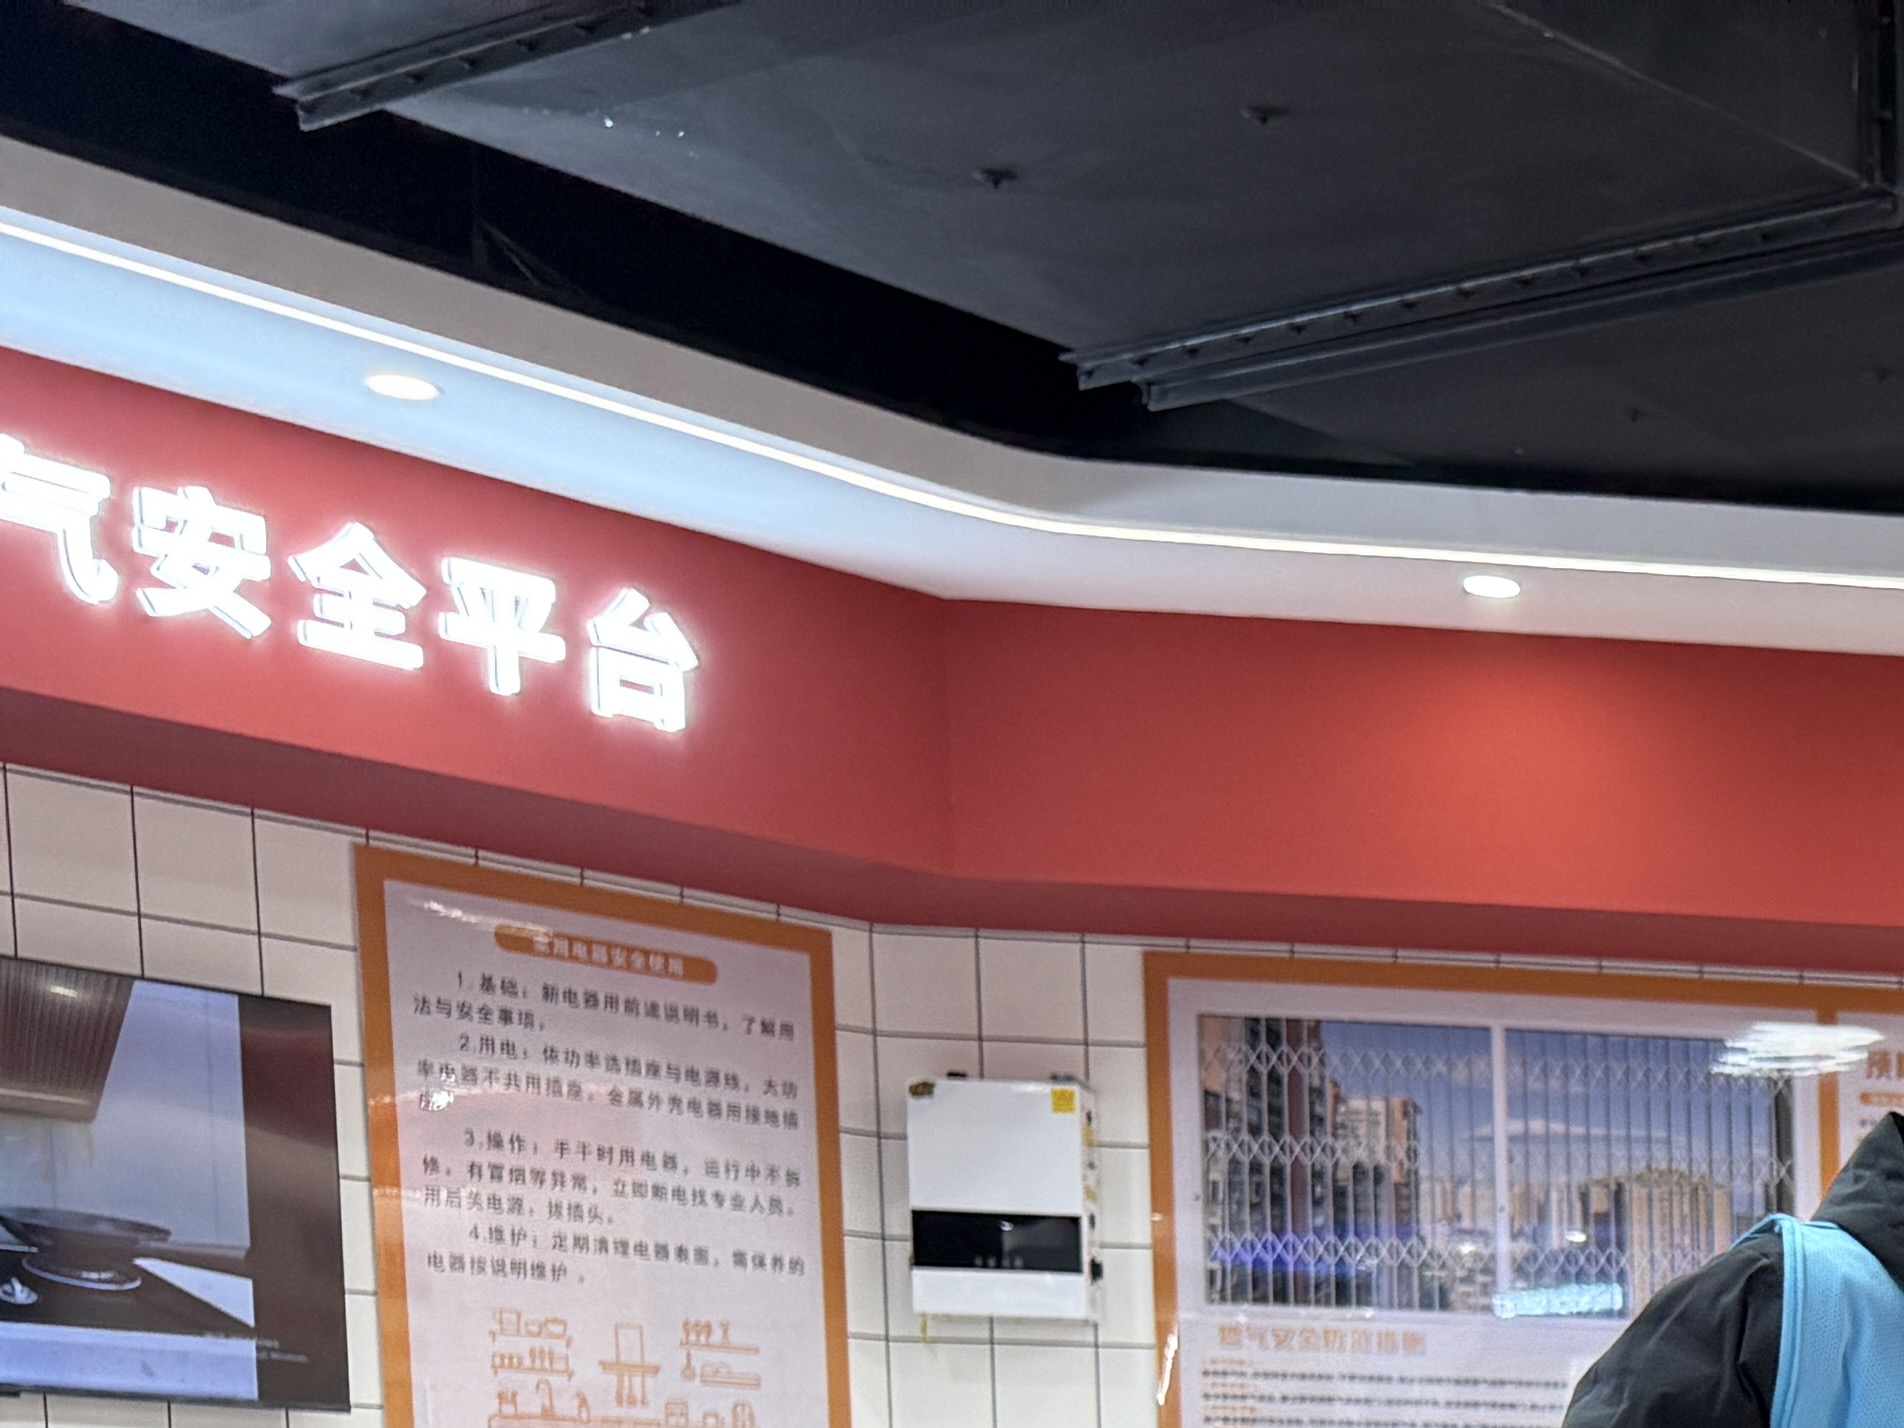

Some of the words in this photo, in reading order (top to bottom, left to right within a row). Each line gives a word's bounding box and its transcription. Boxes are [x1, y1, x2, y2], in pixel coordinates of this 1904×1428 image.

[0, 432, 698, 733] 气安全平台
